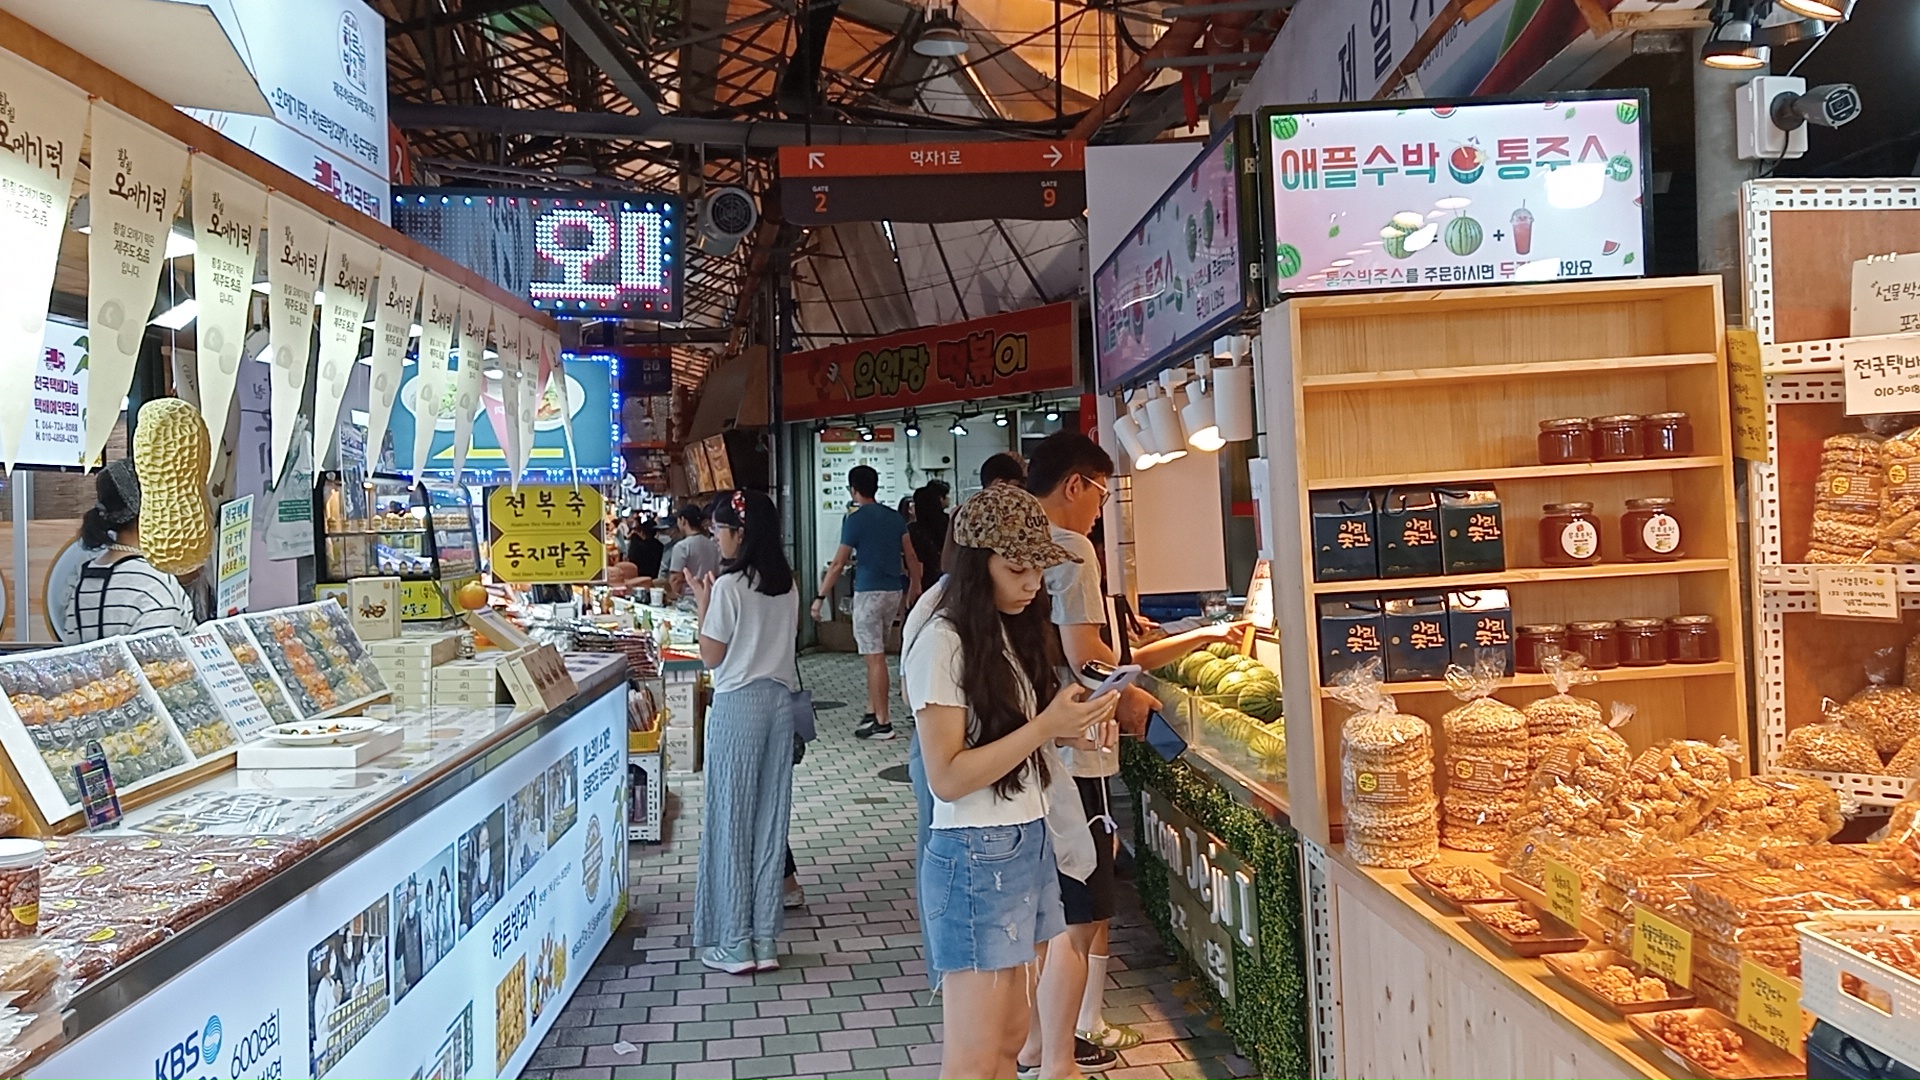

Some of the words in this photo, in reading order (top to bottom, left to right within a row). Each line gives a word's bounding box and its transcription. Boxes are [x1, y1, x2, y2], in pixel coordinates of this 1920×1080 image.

[910, 150, 962, 167] 먹자1로
[1280, 142, 1440, 191] 애플수박
[109, 172, 167, 222] 오메기떡
[815, 194, 827, 213] 2
[1043, 189, 1056, 208] 9
[207, 213, 251, 256] 오메기떡
[280, 245, 317, 281] 오메기떡
[1325, 267, 1419, 288] 통수박주스를
[1425, 264, 1494, 282] 주문하시면
[334, 270, 367, 302] 오메기떡
[1876, 283, 1901, 302] 선물
[34, 375, 79, 395] 전국택배가능
[34, 398, 79, 417] 택배예약문의
[504, 540, 592, 568] 동지팥죽
[1142, 790, 1183, 876] From
[1185, 827, 1233, 924] Jeju
[493, 885, 536, 960] 하르방과자
[155, 1030, 200, 1080] KBS
[231, 1008, 280, 1080] 6008회
